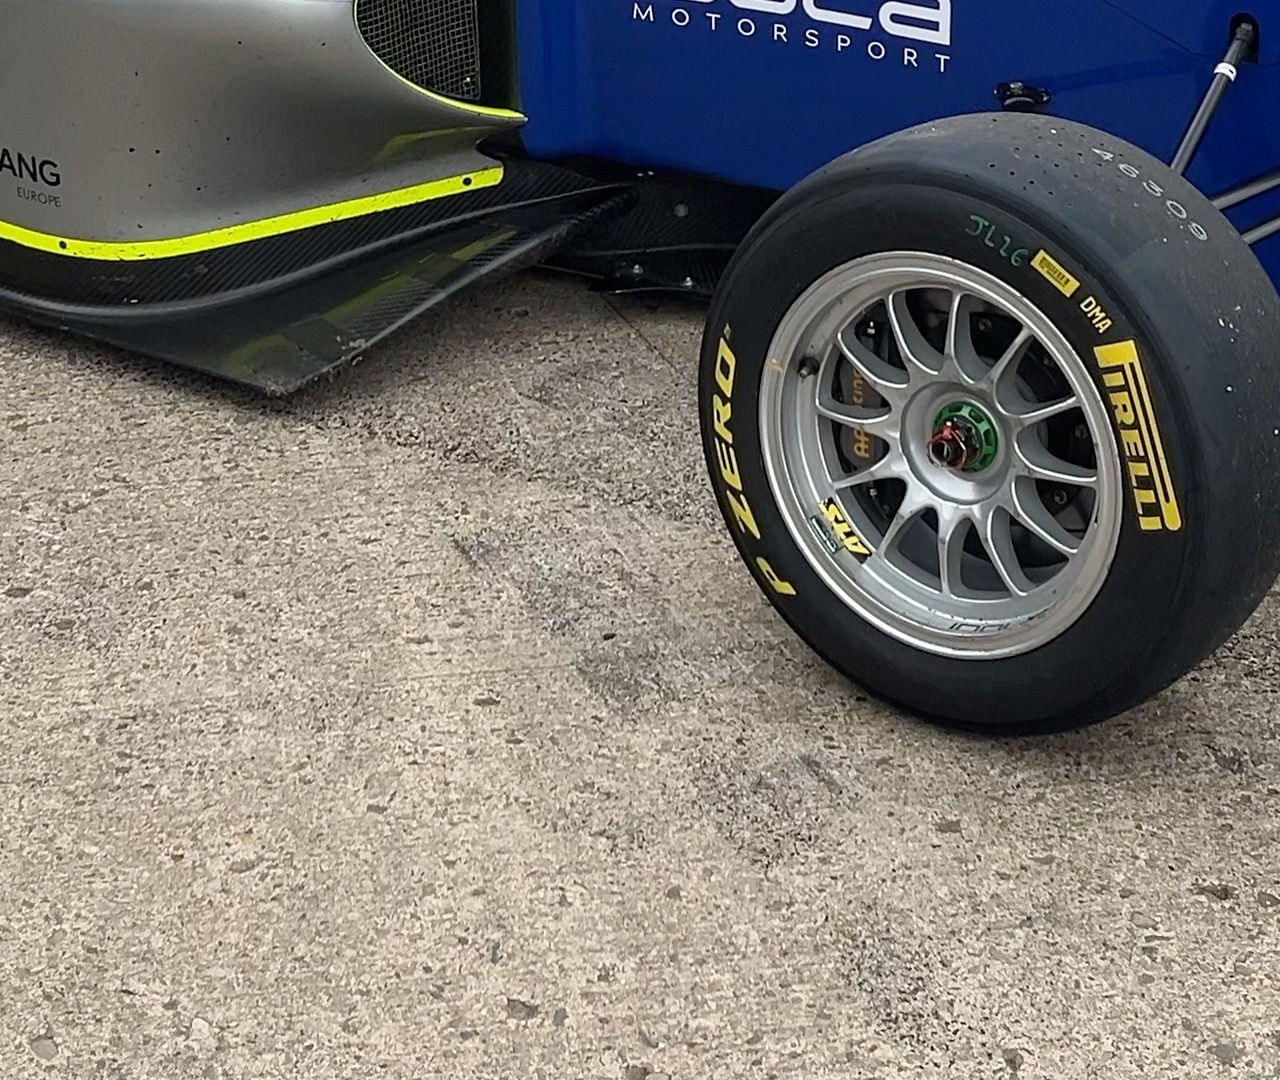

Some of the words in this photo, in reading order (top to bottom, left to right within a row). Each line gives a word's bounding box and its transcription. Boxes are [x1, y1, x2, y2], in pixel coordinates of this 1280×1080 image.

[632, 2, 951, 73] MOTORSPORT
[16, 186, 62, 208] EUROPE
[1079, 296, 1113, 334] DMA
[713, 336, 761, 540] ZERO
[1093, 339, 1182, 532] PIRELLI
[756, 556, 797, 596] P
